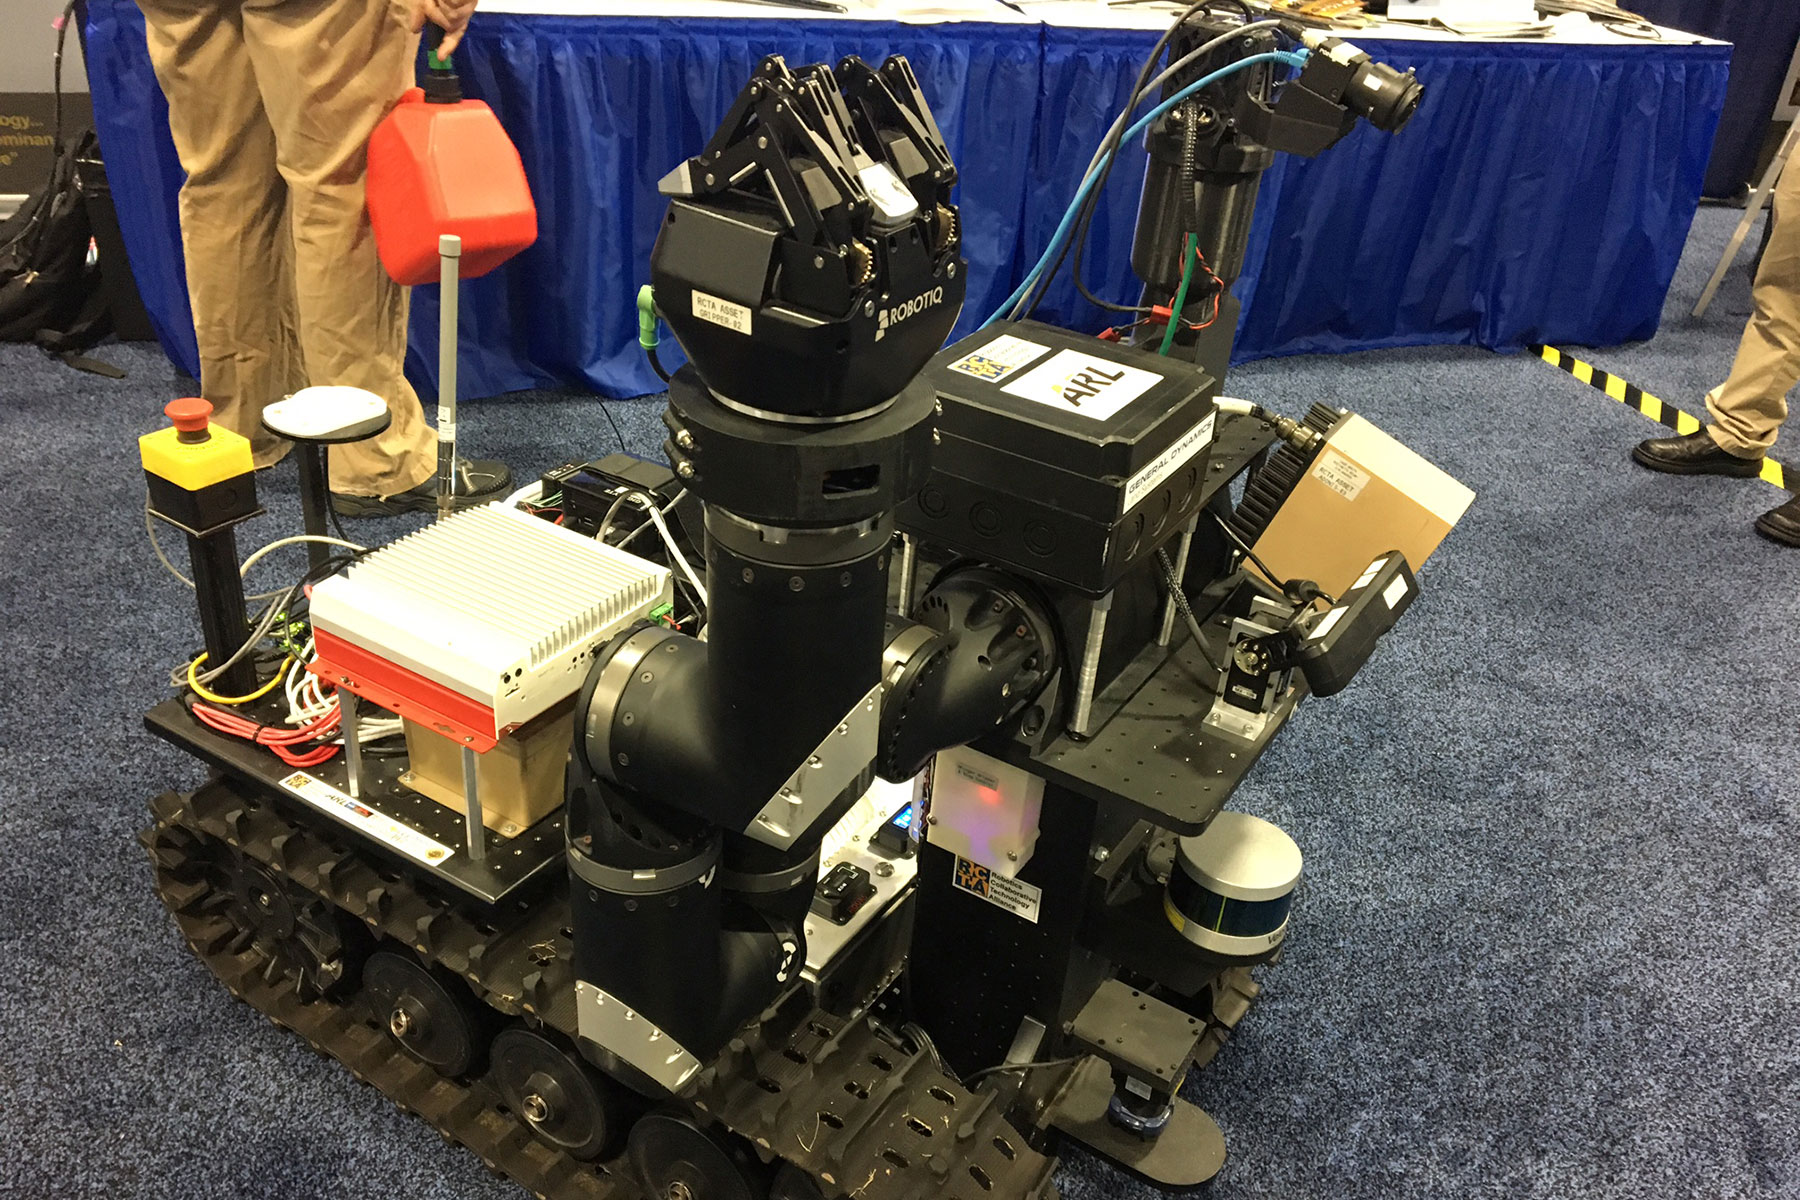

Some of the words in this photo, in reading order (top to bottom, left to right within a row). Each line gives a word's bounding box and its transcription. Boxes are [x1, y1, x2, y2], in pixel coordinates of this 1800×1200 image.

[697, 296, 717, 311] RCTA
[720, 304, 744, 319] ASSET
[890, 286, 943, 326] ROBOTIQ
[1063, 366, 1125, 408] ARL
[1128, 458, 1169, 494] GENERAL
[1170, 419, 1212, 460] DYNAMICS
[990, 879, 1037, 905] Collaborative
[991, 870, 1023, 891] Robotics
[988, 894, 1017, 911] Alliance
[989, 886, 1030, 909] Technology
